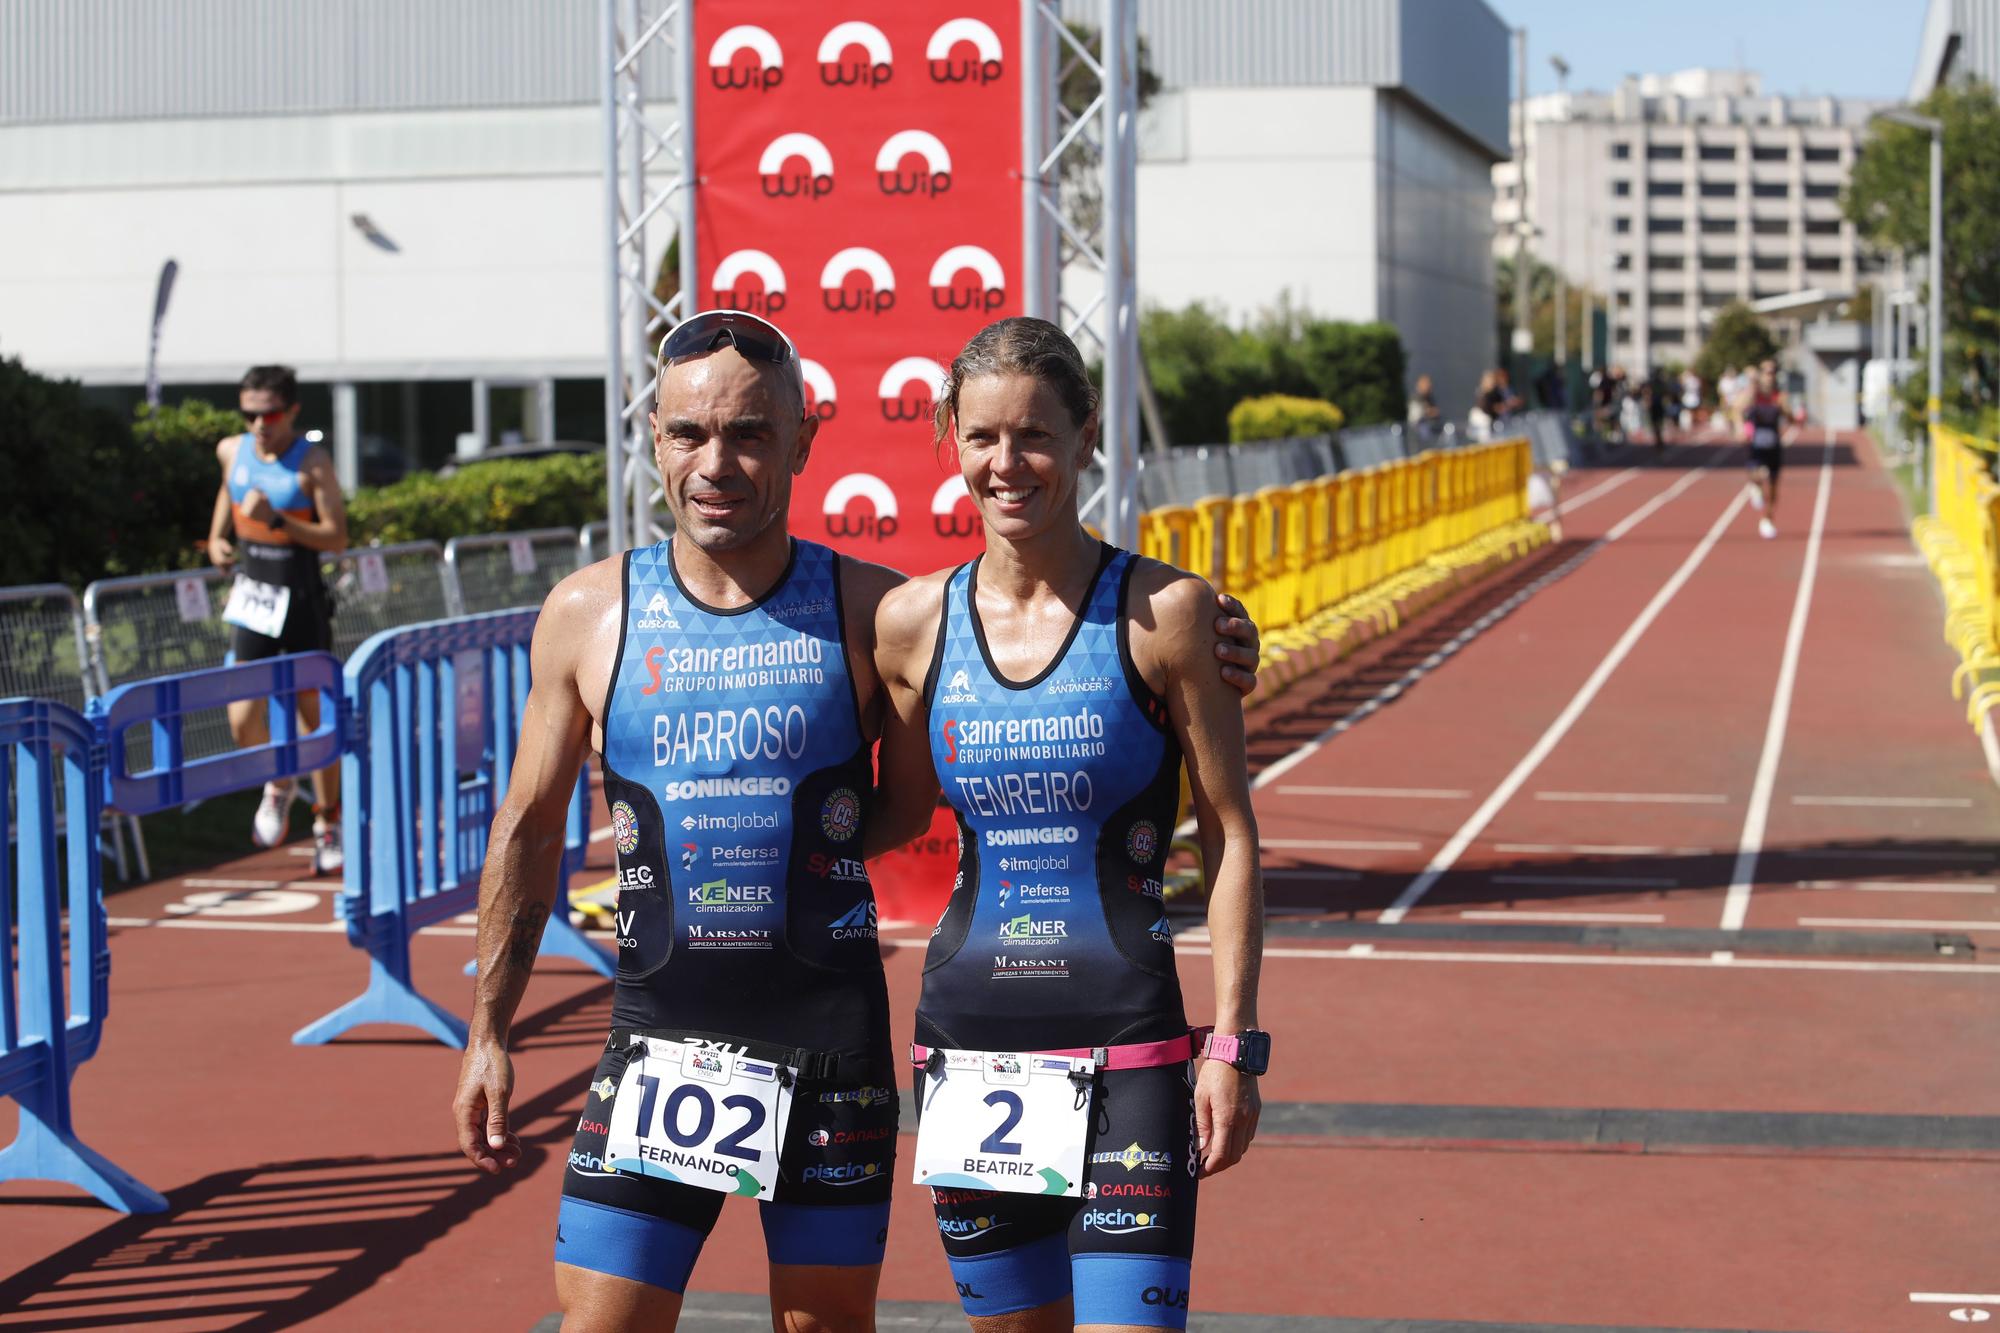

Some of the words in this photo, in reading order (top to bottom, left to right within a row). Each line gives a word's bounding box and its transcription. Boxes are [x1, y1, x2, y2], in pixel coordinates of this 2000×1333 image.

[767, 604, 823, 621] SANTANDER
[665, 675, 716, 693] GRUPO
[719, 668, 824, 691] INMOBILIARIO
[1048, 682, 1102, 695] SANTANDER
[653, 704, 807, 767] BARROSO
[959, 748, 1002, 764] GRUPO
[1004, 742, 1105, 762] INMOBILIARIO
[665, 777, 791, 801] SONINGEO
[955, 770, 1093, 818] TENREIRO
[698, 811, 779, 832] itmglobal
[833, 803, 852, 828] CC
[986, 826, 1079, 847] SONINGEO
[712, 845, 779, 860] Pefersa
[1010, 855, 1069, 874] itmglobal
[1020, 883, 1070, 897] Pefersa
[695, 903, 763, 913] climatización
[1003, 936, 1060, 946] climatización
[634, 1074, 766, 1163] 102
[980, 1090, 1024, 1155] 2
[638, 1145, 740, 1177] FERNANDO
[963, 1158, 1034, 1177] BEATRIZ
[1083, 1208, 1158, 1231] piscinor
